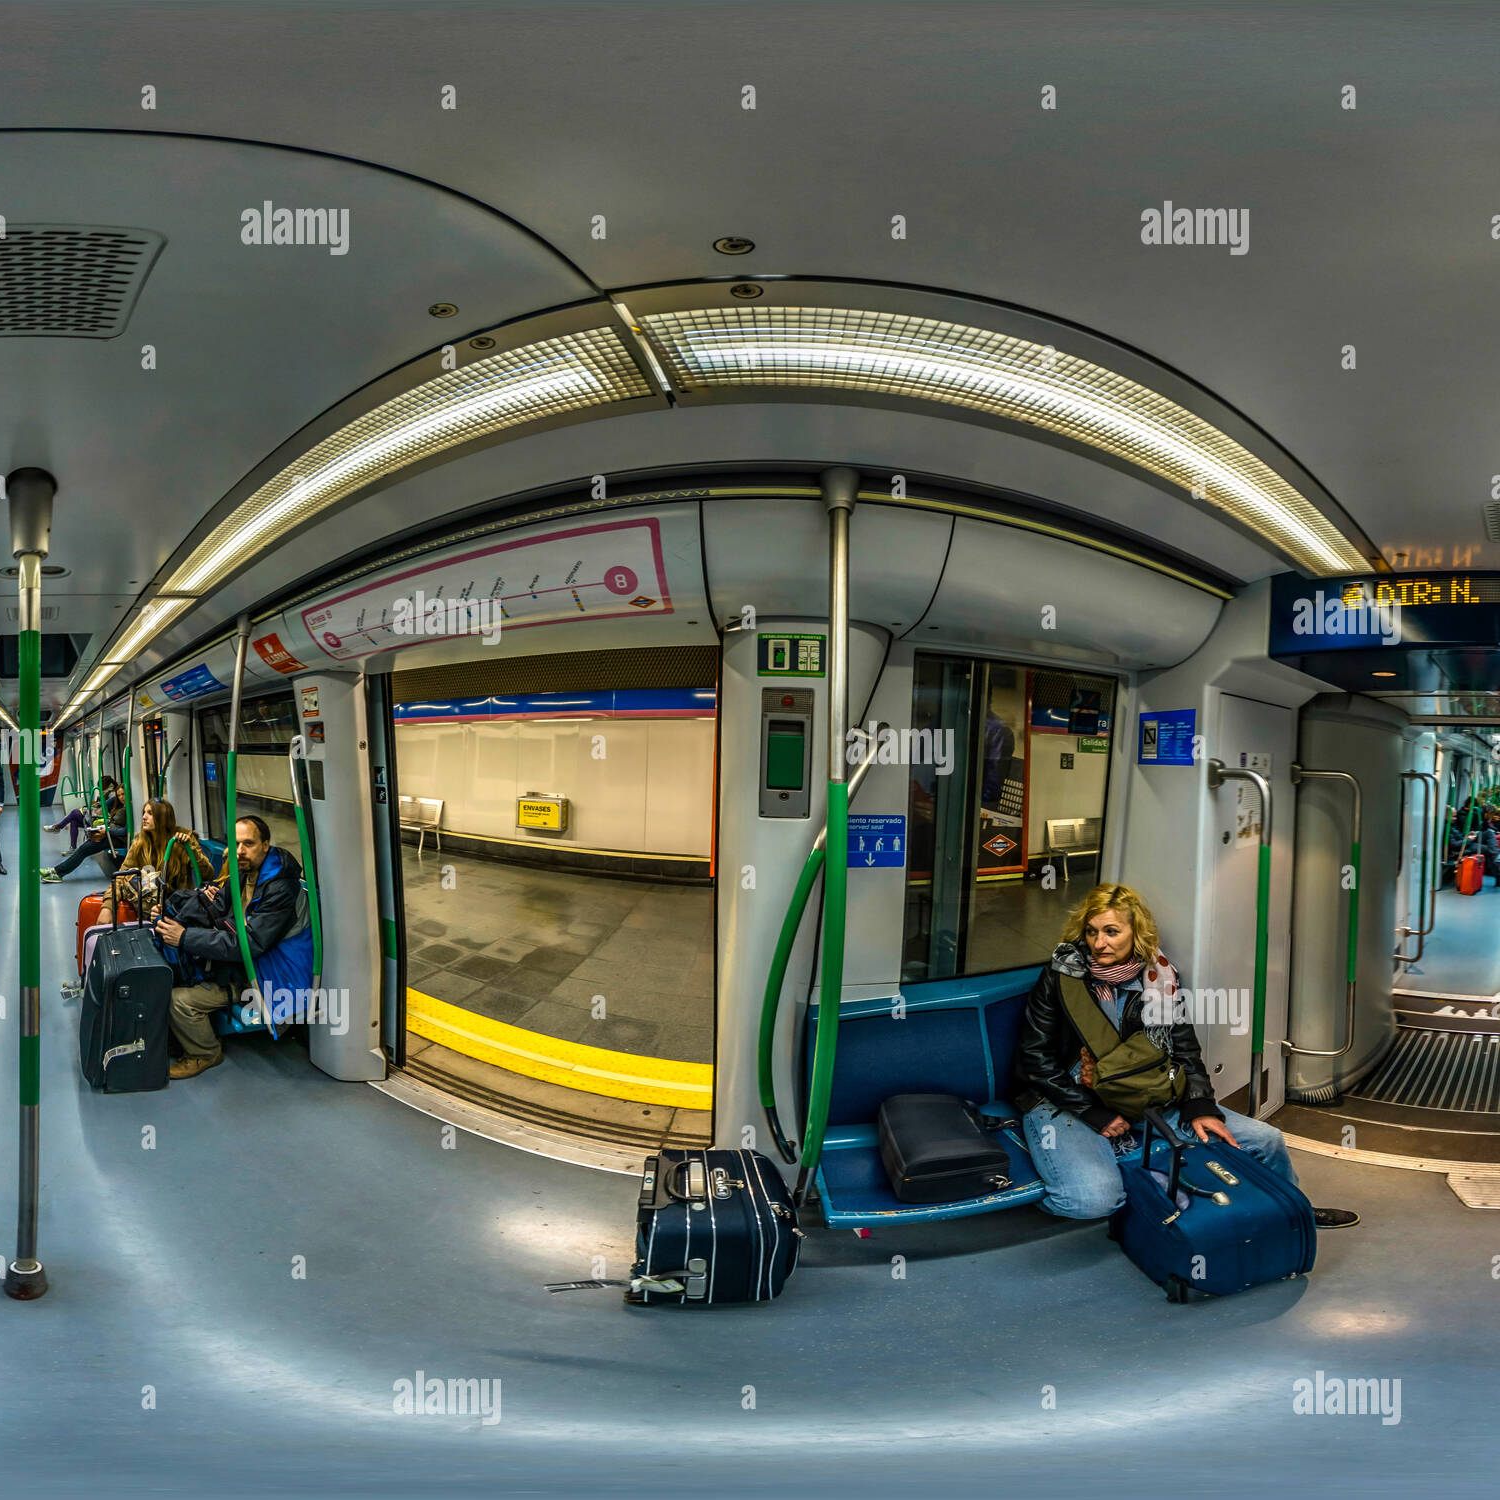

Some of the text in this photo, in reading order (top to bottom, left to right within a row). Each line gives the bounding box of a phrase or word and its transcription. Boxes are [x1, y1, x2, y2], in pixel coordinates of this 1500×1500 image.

[614, 573, 628, 589] 8
[1376, 576, 1480, 608] DIR: N.
[523, 804, 551, 813] ENVASES
